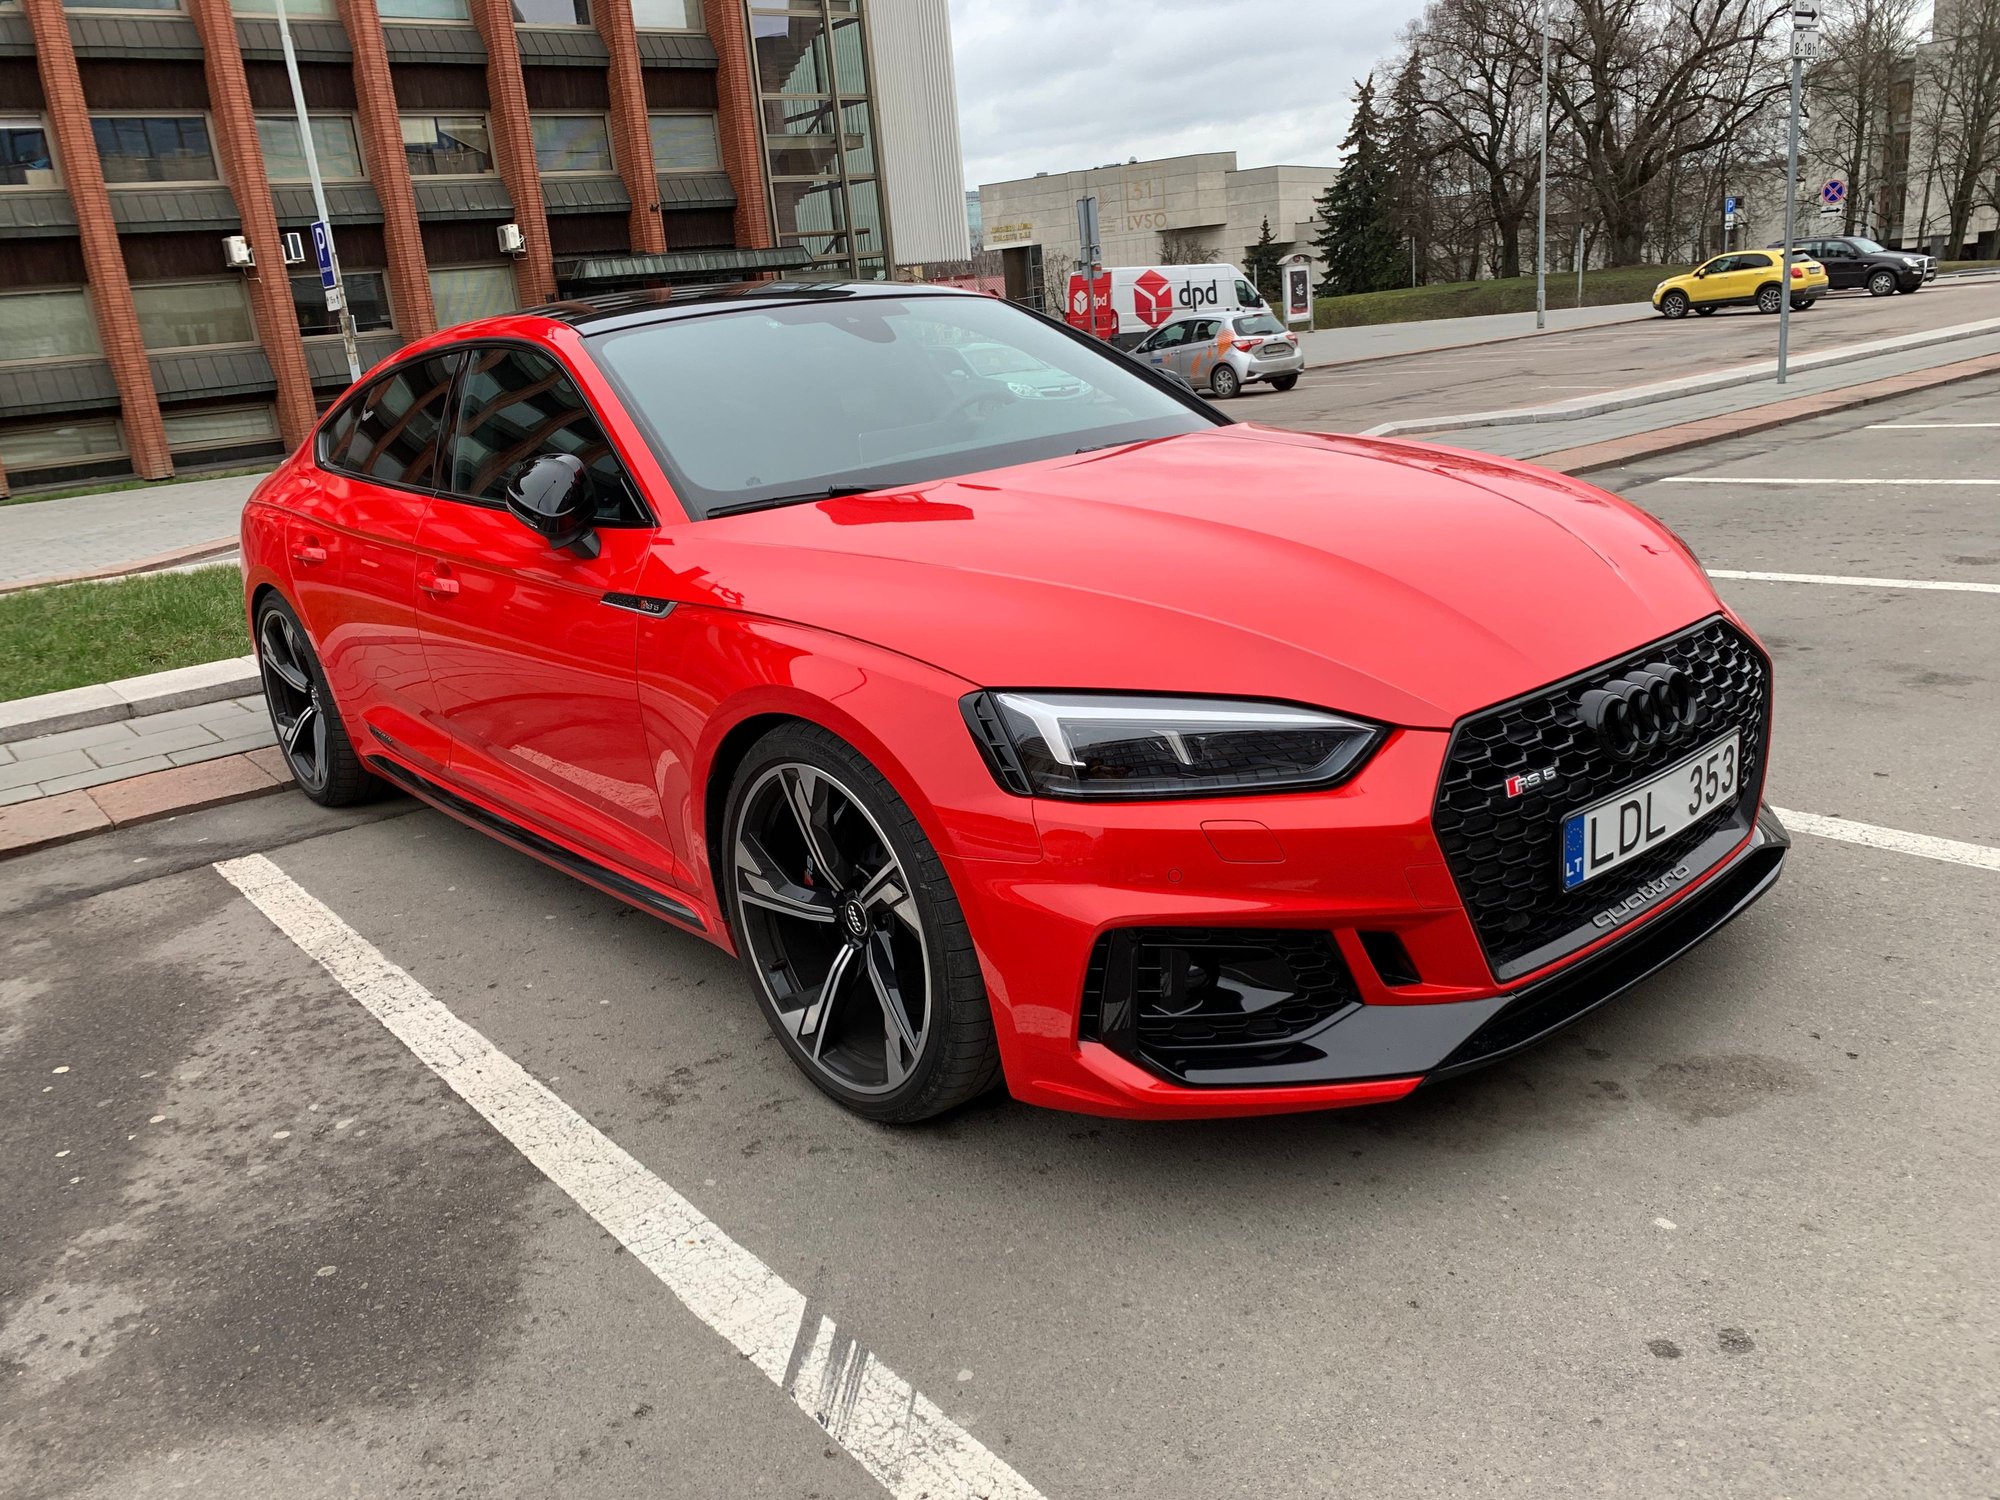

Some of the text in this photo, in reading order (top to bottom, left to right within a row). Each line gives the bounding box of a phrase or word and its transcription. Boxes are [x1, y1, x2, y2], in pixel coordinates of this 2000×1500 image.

[1127, 212, 1167, 231] LVSO
[315, 227, 326, 262] P
[1178, 279, 1218, 312] dpd
[1510, 766, 1557, 796] RS 5
[1590, 744, 1735, 870] LDL 353
[1566, 857, 1582, 877] LT
[1592, 864, 1691, 927] quattro
